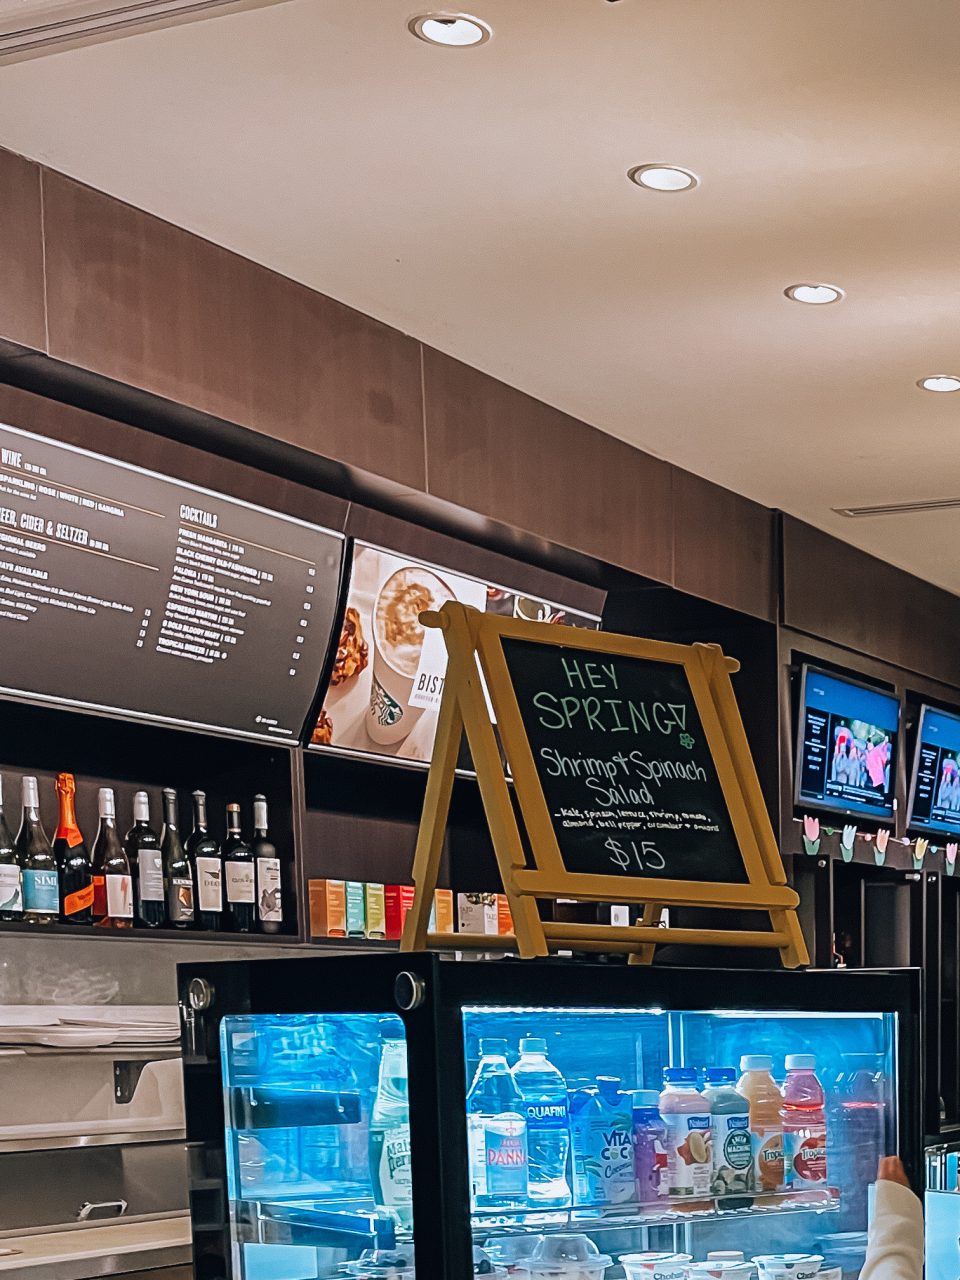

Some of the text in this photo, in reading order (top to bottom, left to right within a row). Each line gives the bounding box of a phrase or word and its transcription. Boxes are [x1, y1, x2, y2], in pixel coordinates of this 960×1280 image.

[1, 448, 22, 468] WINE
[180, 504, 218, 528] COCKTAILS
[0, 507, 17, 527] EER,
[20, 513, 45, 533] CIDER
[46, 520, 54, 535] &
[55, 523, 89, 546] SELTZER
[561, 657, 618, 690] HEY
[417, 673, 445, 695] BIST
[540, 747, 617, 786] Shrimp
[629, 750, 708, 788] Spinach
[585, 776, 656, 807] Salad
[604, 836, 666, 871] $15
[527, 1105, 566, 1120] QUAFIN
[386, 1139, 411, 1157] Mai
[602, 1130, 632, 1147] VITA
[487, 1148, 527, 1166] PANN
[763, 1148, 785, 1161] Tropic
[803, 1147, 826, 1159] Tropic
[388, 1154, 411, 1180] per
[653, 1271, 684, 1280] Choba
[796, 1271, 817, 1280] Chob
